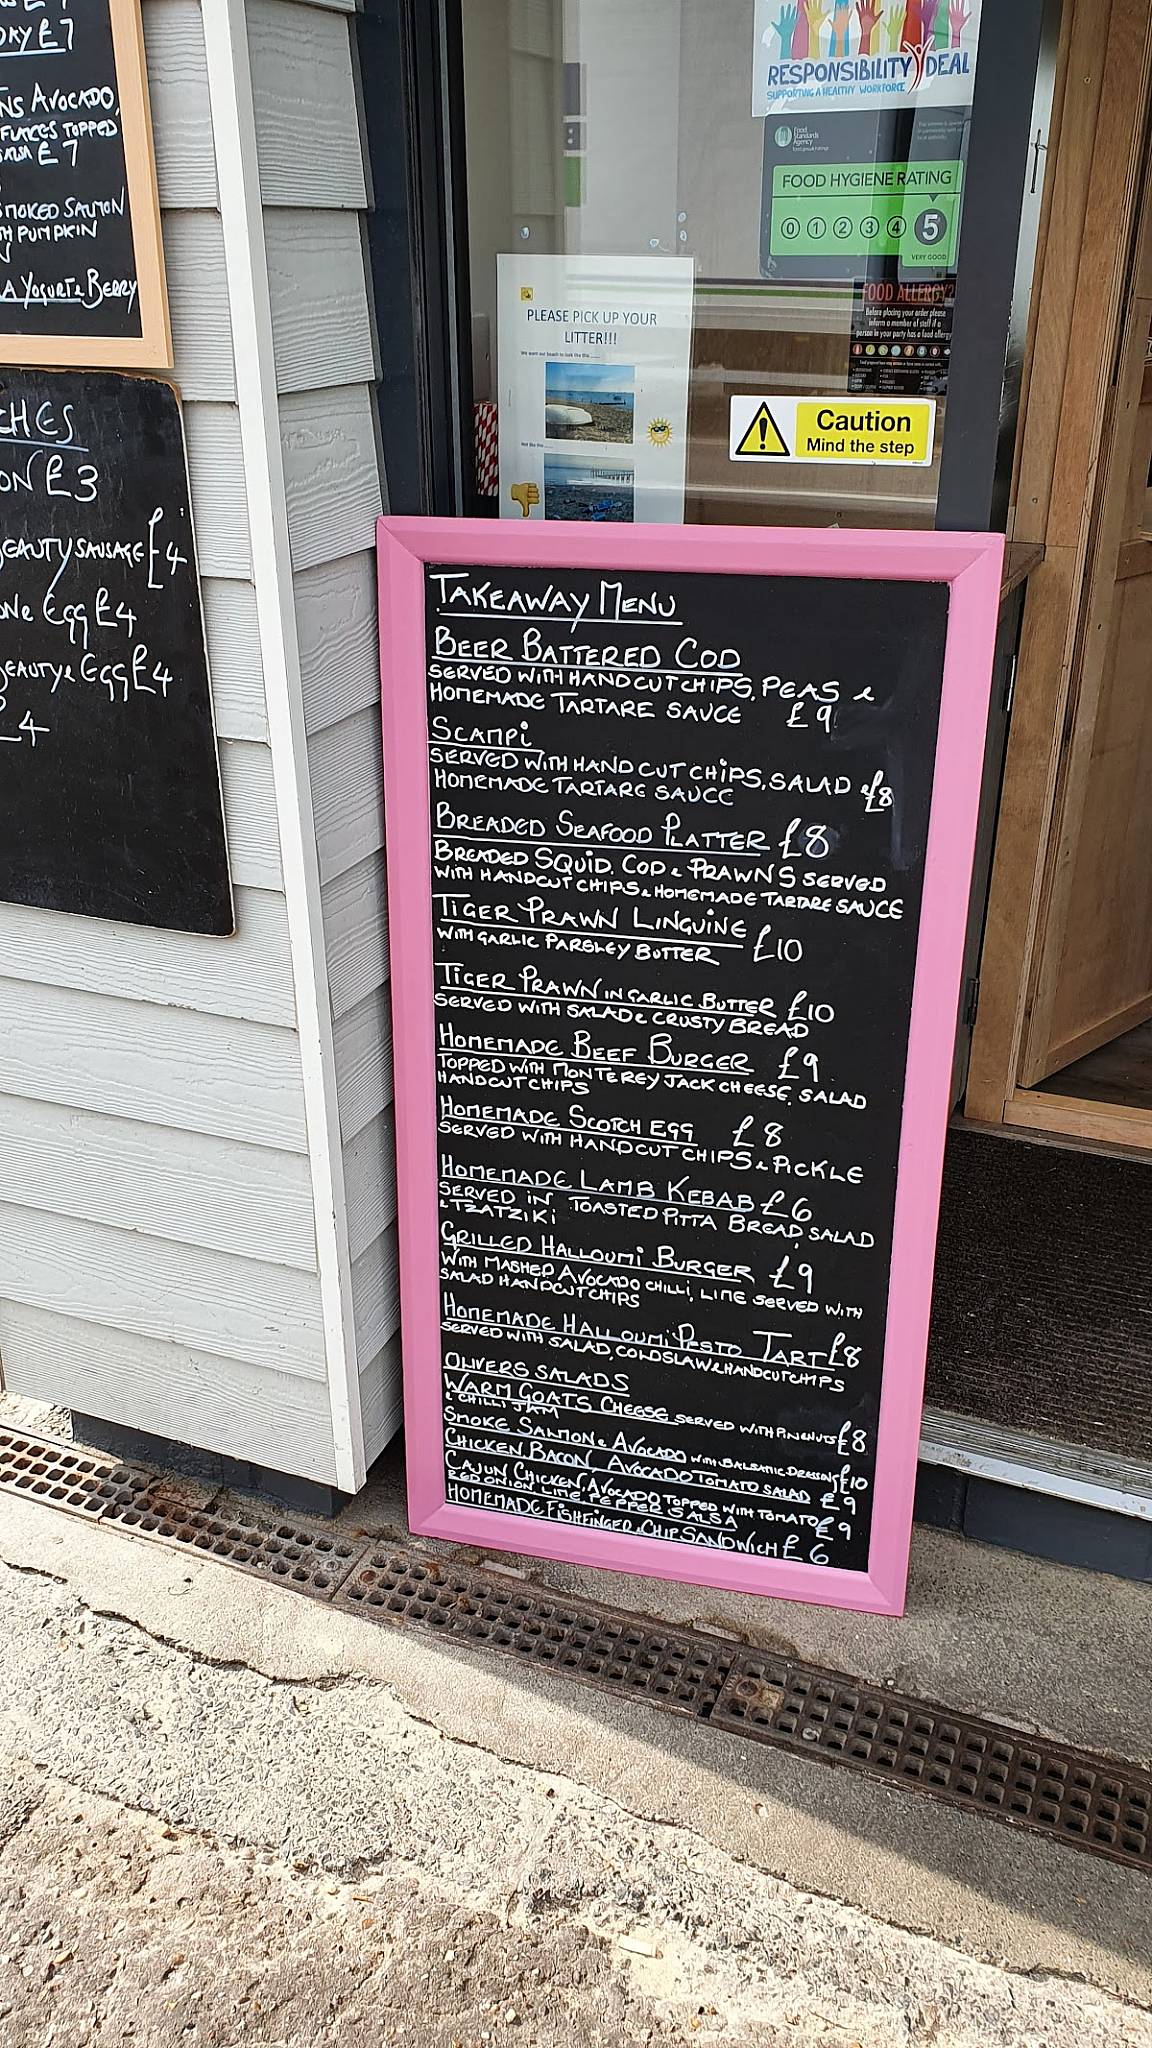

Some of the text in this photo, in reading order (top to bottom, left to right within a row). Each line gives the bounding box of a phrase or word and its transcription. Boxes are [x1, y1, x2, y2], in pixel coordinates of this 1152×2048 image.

[767, 52, 970, 86] RESPONSIBILITY DEAL
[767, 82, 905, 100] SUPPORTING HEALTHY WORKFORCE
[63, 119, 117, 138] TOPPED
[783, 170, 952, 188] FOOD HYGIENE RATING
[18, 220, 97, 243] PUMPKIN
[922, 214, 939, 240] 5
[864, 284, 954, 302] FOOD ALLERGY?
[866, 307, 946, 318] Before placing your order please
[527, 309, 657, 325] PLEASE PICK UP YOUR
[565, 331, 617, 345] LITTER!!!
[817, 409, 911, 432] Caution
[807, 437, 914, 456] Mind the step
[47, 455, 98, 502] £3
[429, 573, 676, 633] TAKEAWAY MENU
[435, 626, 741, 669] BEER BATTERED COD
[428, 664, 840, 703] SERVED WITH PEAS
[430, 682, 742, 724] HOMEMADE TARTARE SAUCE
[432, 716, 532, 747] SCAMPI
[430, 748, 850, 795] SERVED WITH SALAD
[434, 769, 734, 806] HOMEMADE TARTARE SAUCE
[437, 801, 771, 851] BREADED SEAFOOD PLATTER
[434, 839, 886, 892] BREADED COD PRAWNS SERVED
[434, 865, 903, 919] WITH HOMEMADE TARTARE SAUCE
[432, 893, 802, 963] TIGER PRAWN LINGUINE £10
[437, 926, 720, 966] WITH GARLIC PARSLEY BUTTER
[435, 963, 834, 1023] TIGER PRAWN GARLIC BUTTER £10
[434, 993, 809, 1038] SERVED WITH CRUSTY BREAD
[440, 1023, 755, 1073] HOMEMADE BEEF BURGER
[437, 1053, 866, 1109] TOPPED WITH MONTEREY JACK SALAD
[440, 1095, 693, 1142] HOMEMADE SCOTCH EGG
[438, 1121, 863, 1184] SERVED WITH PICKLE
[442, 1154, 754, 1212] HOMEMADE LAMB KEBAB
[439, 1181, 875, 1248] SERVED IN TOASTED PITTA SALAD
[450, 1199, 556, 1224] TZATZIKI
[441, 1221, 755, 1284] GRILLED HALLOUMI BURGER
[440, 1269, 494, 1285] SALAD
[441, 1250, 863, 1319] WITH MASHED AVOCADO LIME SERVED WITH
[440, 1322, 543, 1343] SERVED WITH
[444, 1292, 827, 1368] HOMEMADE TART
[445, 1352, 629, 1391] OLIVERS SALADS
[444, 1373, 735, 1431] WARM GOATS SERVED
[458, 1394, 559, 1419] CHILLI JAM
[444, 1406, 686, 1463] SMOKE SALMON AVOCADO
[446, 1450, 819, 1527] CAJUN AVOCADO TOPPED WITH TOMATO
[608, 1455, 810, 1504] AVOCADO TOMATO SALAD
[449, 1483, 777, 1557] HOMEMADE CHIP SANDWICH
